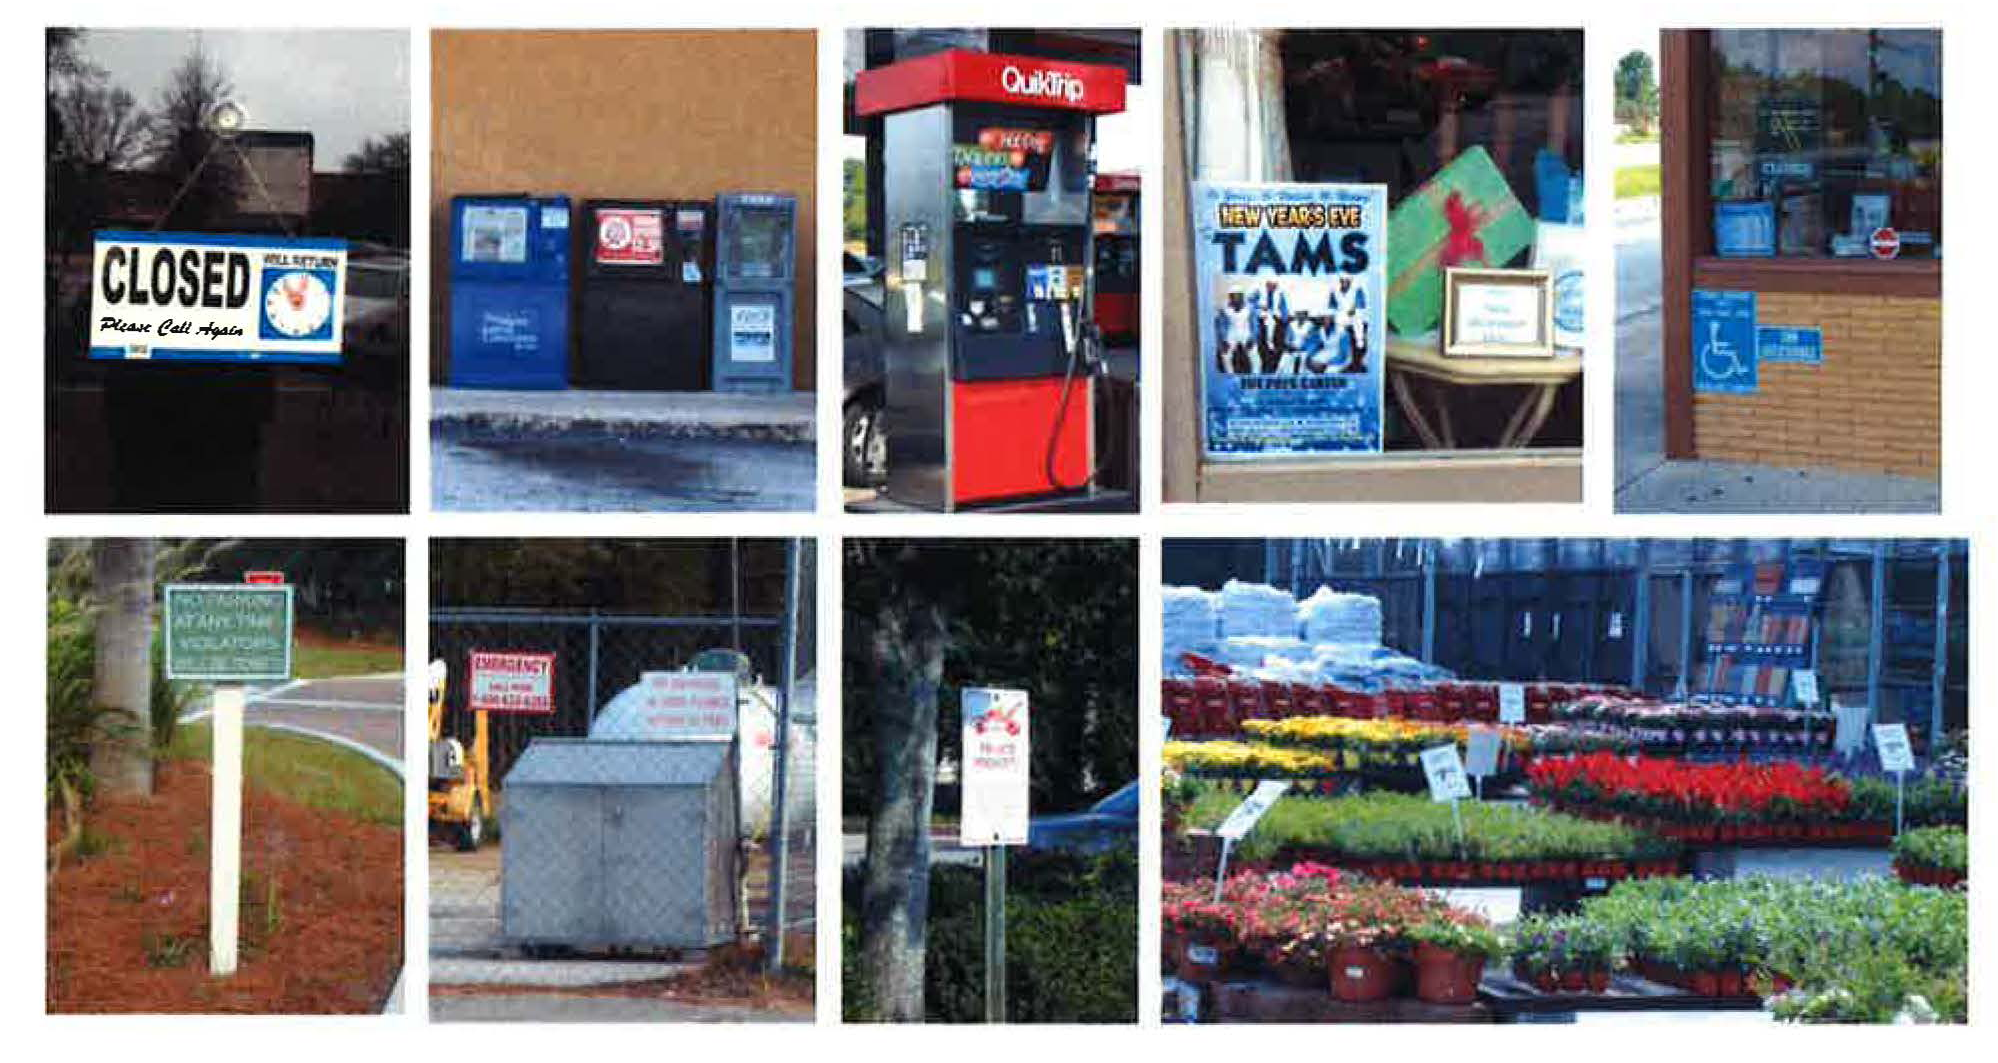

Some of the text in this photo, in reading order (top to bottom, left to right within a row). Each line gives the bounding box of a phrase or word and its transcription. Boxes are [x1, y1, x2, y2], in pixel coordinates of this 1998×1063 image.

[1002, 66, 1084, 101] QuikTrip
[1218, 203, 1362, 229] NEW YEAR'S EVE
[292, 255, 338, 268] RETURN
[1211, 229, 1369, 276] TAMS
[102, 246, 250, 309] CLOSED
[100, 317, 244, 340] Please Call Again
[475, 654, 548, 674] EMERGENCY
